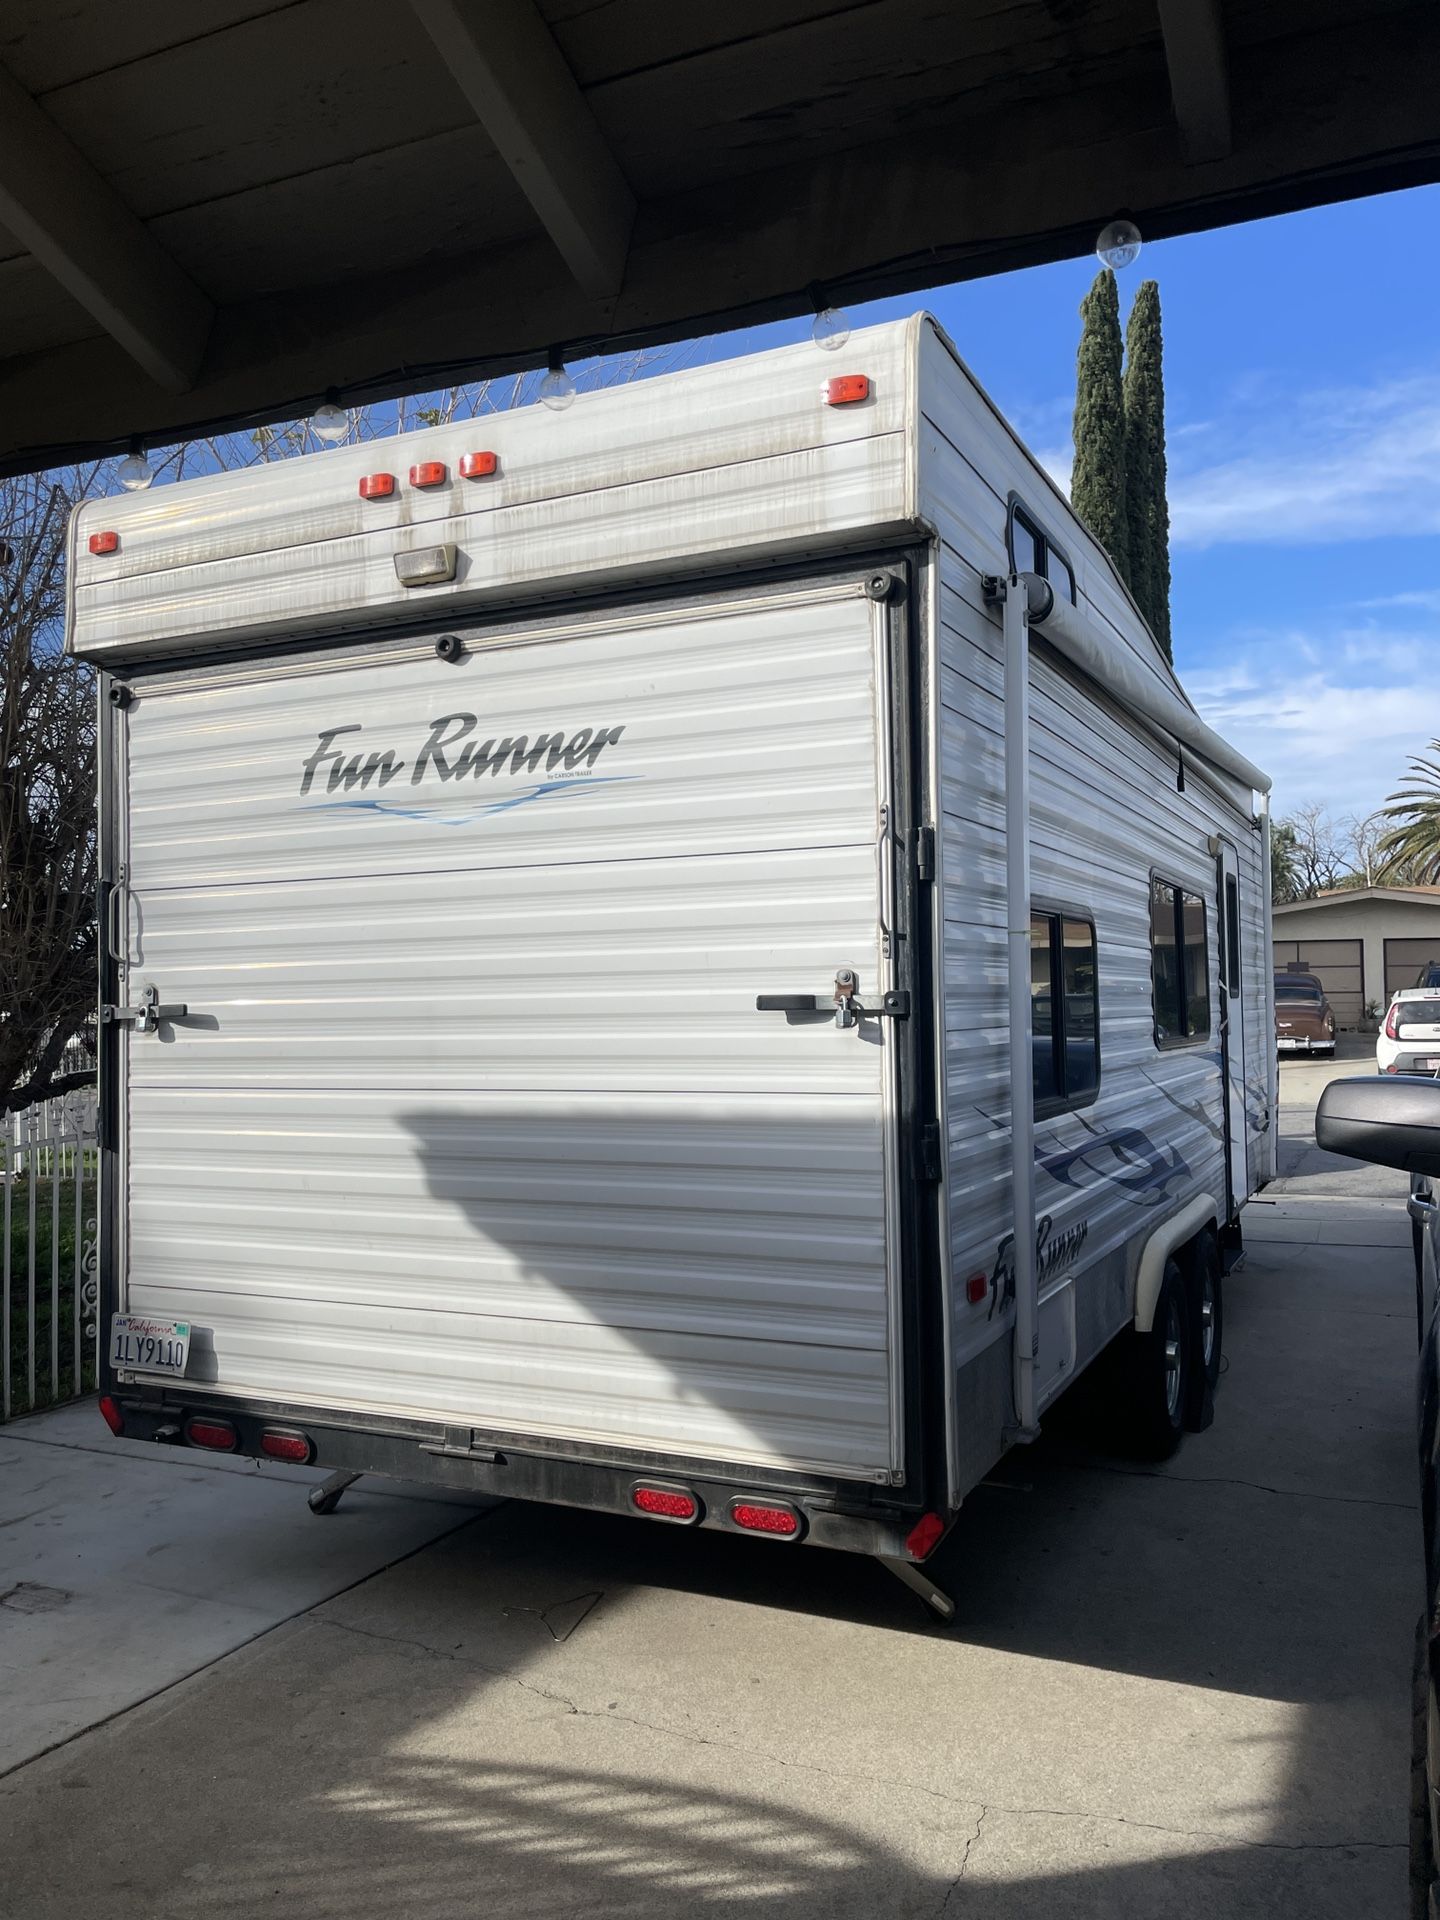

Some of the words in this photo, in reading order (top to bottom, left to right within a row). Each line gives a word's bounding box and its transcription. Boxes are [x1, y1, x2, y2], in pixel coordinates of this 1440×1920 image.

[300, 724, 405, 797] Fun
[411, 712, 626, 785] Runner
[554, 771, 575, 779] CARSON
[128, 1318, 172, 1336] California
[115, 1334, 183, 1367] 1LY9110
